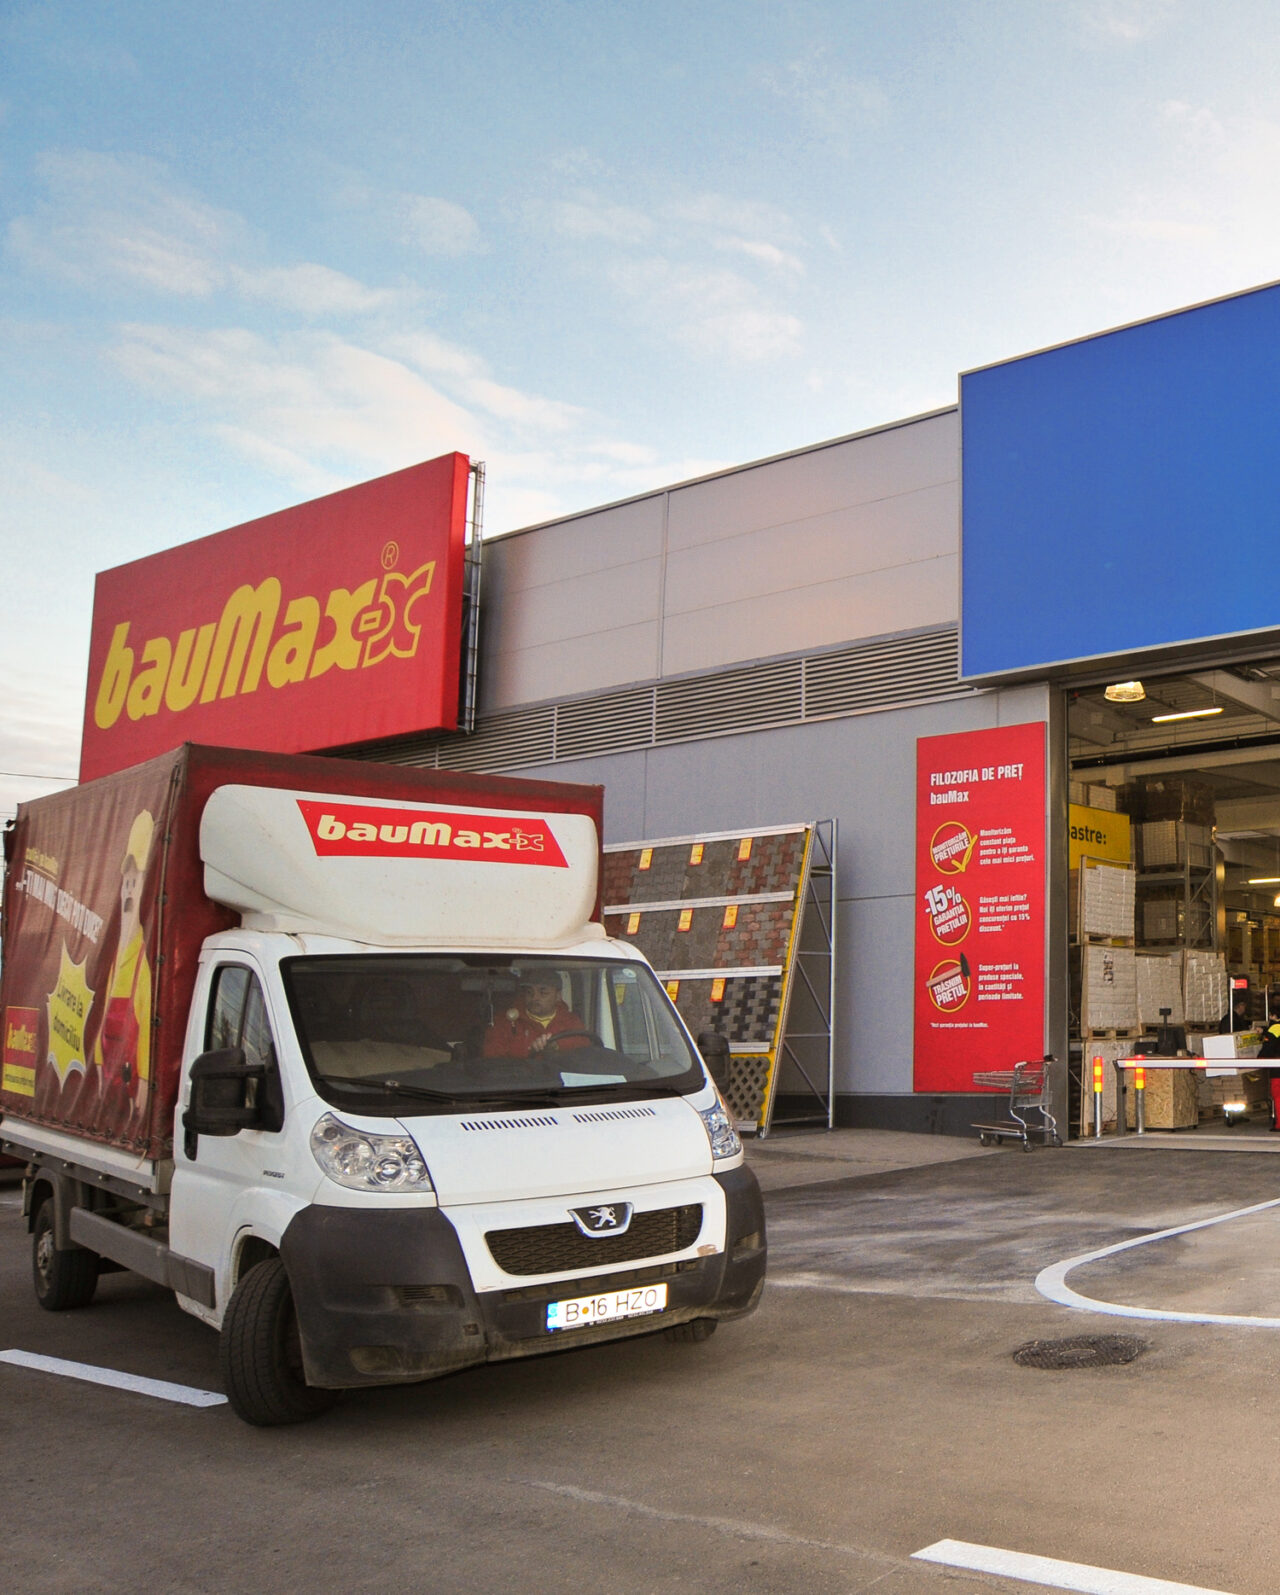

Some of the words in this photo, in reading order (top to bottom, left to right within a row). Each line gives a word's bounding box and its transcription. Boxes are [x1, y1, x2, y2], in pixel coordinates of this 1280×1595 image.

[930, 768, 979, 786] FILOZOFIA
[981, 767, 995, 781] DE
[997, 763, 1024, 780] PREȚ
[930, 790, 970, 805] bauMax
[1069, 825, 1107, 845] astre:
[925, 884, 962, 916] -15%
[565, 1302, 579, 1322] B
[590, 1298, 607, 1317] 16
